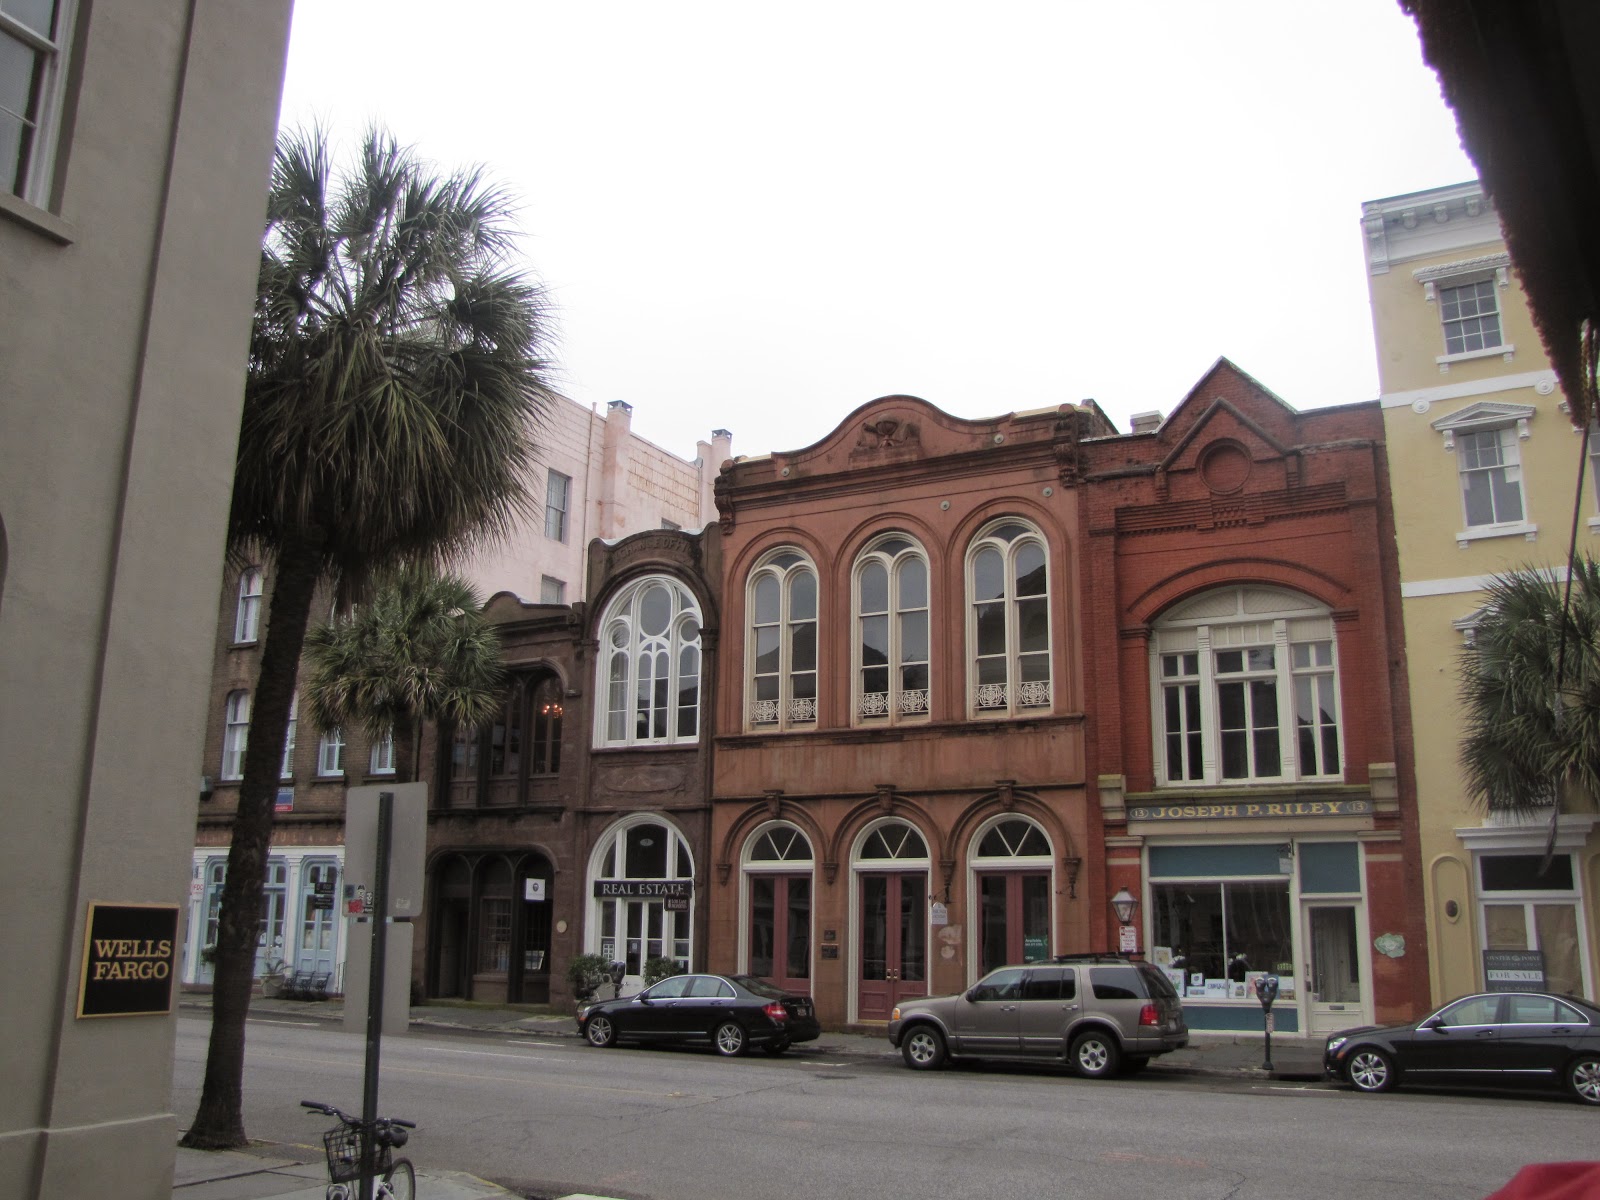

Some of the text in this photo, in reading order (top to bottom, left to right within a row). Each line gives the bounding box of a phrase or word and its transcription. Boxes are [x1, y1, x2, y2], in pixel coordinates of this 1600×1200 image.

[1134, 809, 1146, 817] 13
[1152, 806, 1237, 819] JOSEPH
[1265, 802, 1343, 815] RILEY
[1351, 803, 1364, 812] 13
[602, 883, 685, 895] REAL ESTATE
[94, 939, 172, 958] WELLS
[93, 960, 170, 980] FARGO
[1489, 971, 1542, 980] FOR SALE
